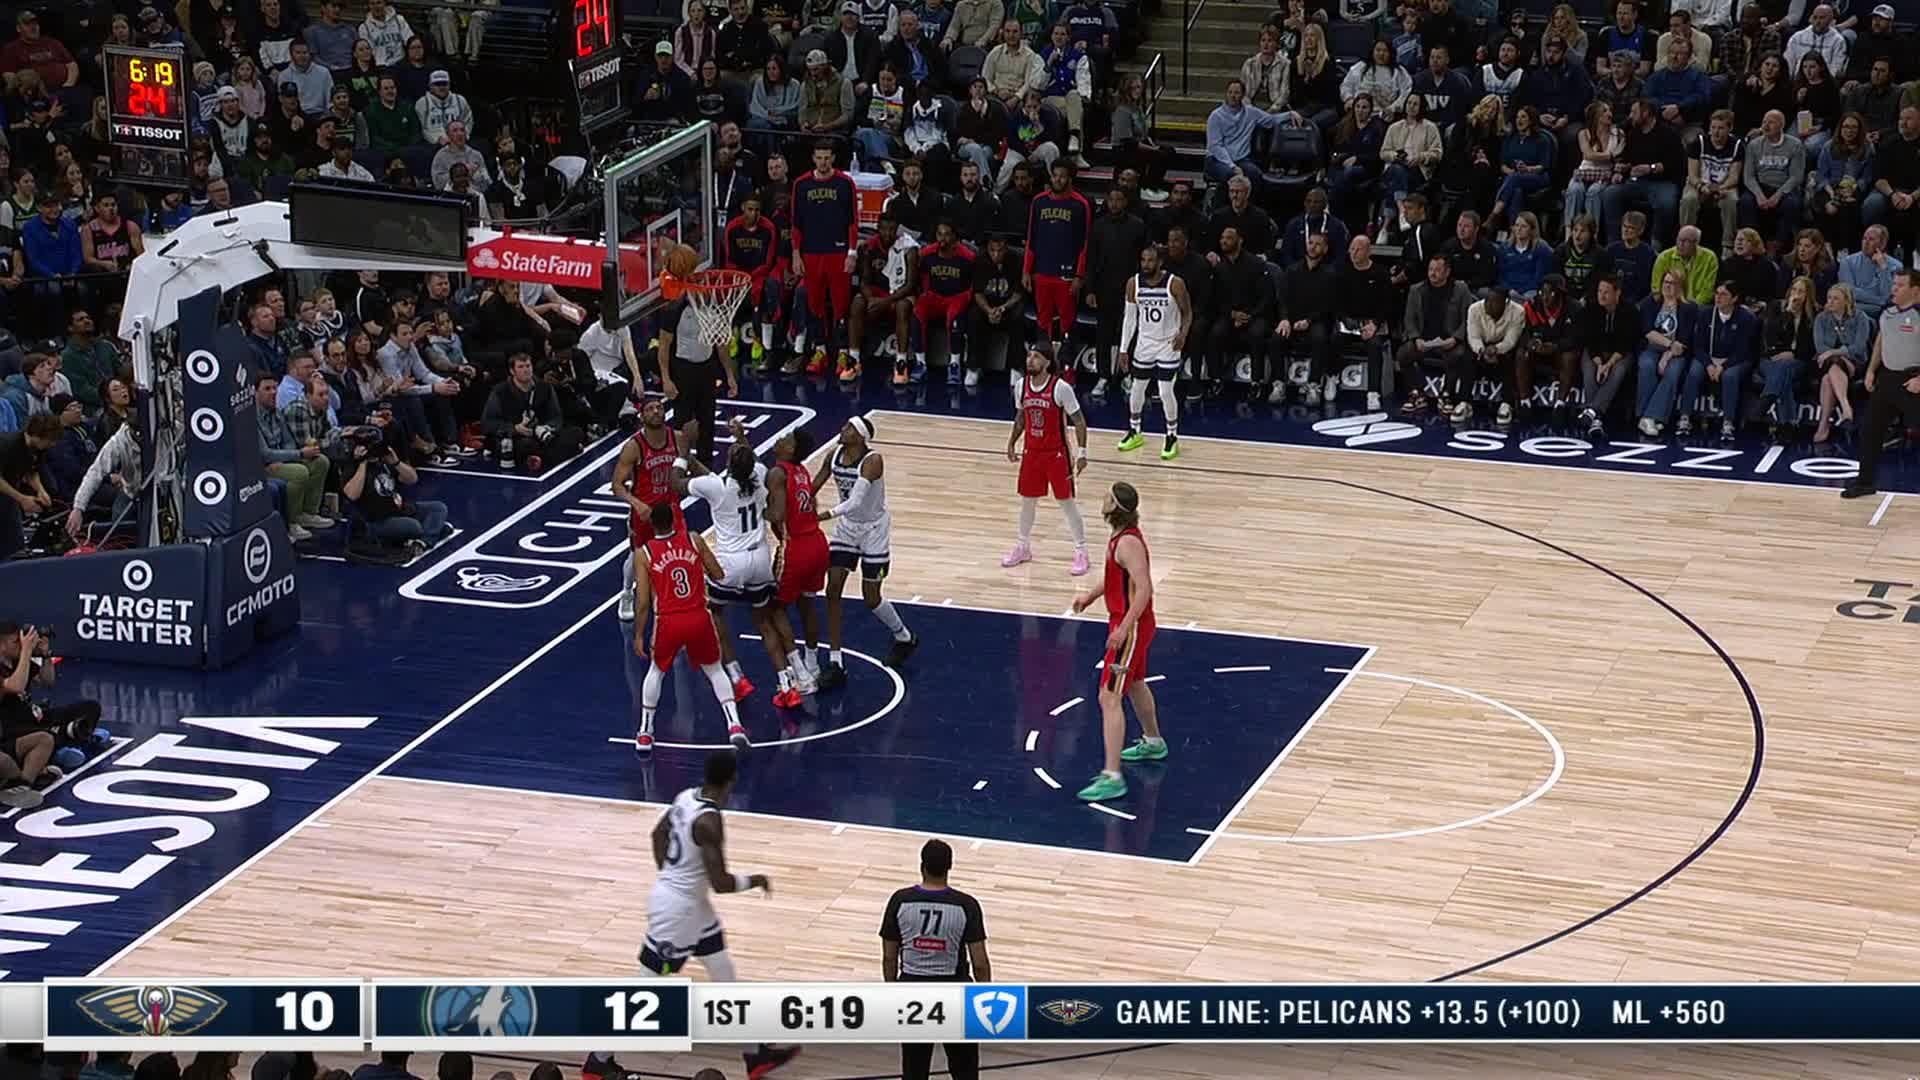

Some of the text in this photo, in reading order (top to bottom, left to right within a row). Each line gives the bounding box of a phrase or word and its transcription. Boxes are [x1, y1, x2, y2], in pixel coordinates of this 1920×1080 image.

[576, 0, 610, 56] 24
[129, 58, 174, 86] 6:19
[128, 83, 167, 114] 24
[134, 126, 183, 141] TISSOT
[1144, 306, 1162, 323] 10
[1446, 429, 1861, 479] sezzle
[737, 502, 758, 534] 11
[671, 567, 691, 599] 3
[79, 593, 194, 622] TARGET
[226, 574, 295, 627] CFMOTO
[77, 618, 193, 646] CENTER
[919, 909, 943, 937] 77
